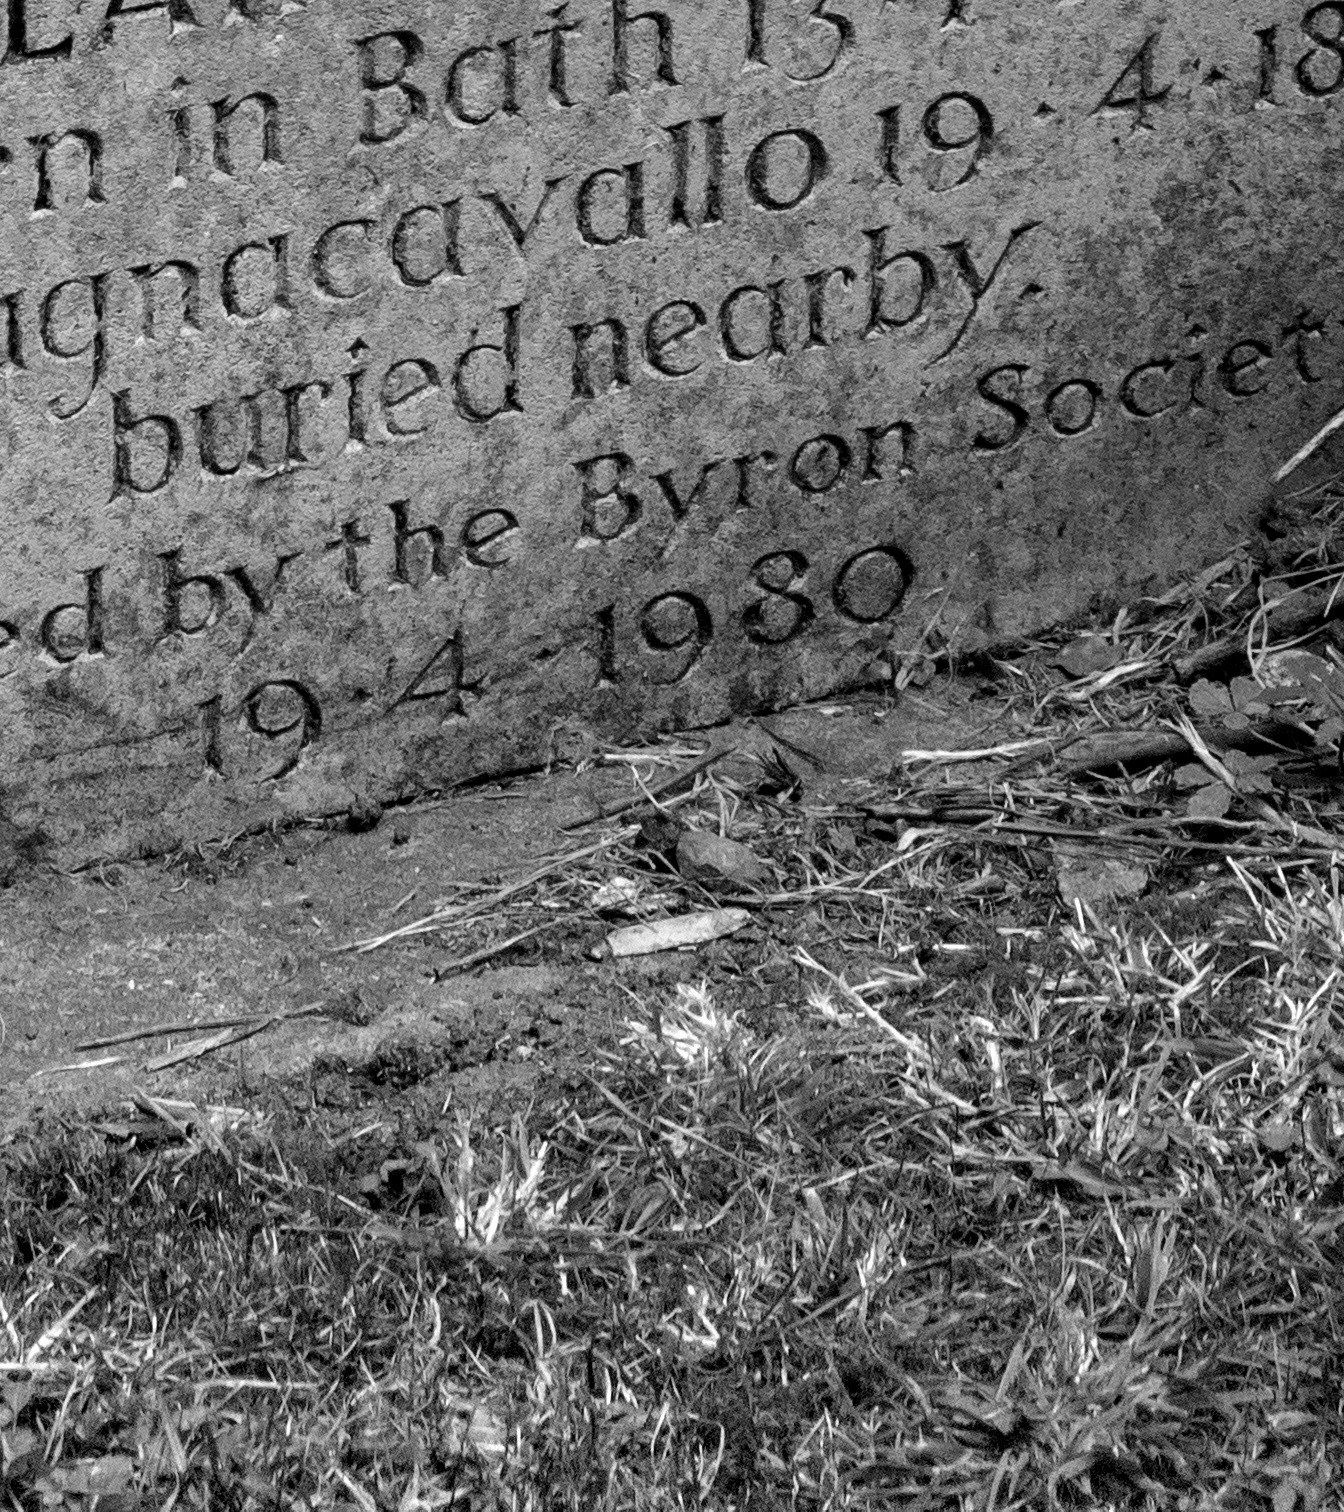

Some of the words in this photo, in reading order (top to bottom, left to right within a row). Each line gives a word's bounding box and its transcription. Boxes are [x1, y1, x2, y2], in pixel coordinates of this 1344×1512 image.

[165, 77, 285, 186] in
[109, 303, 524, 506] buried
[157, 547, 306, 658] by
[323, 499, 518, 594] the
[573, 420, 918, 563] Byron
